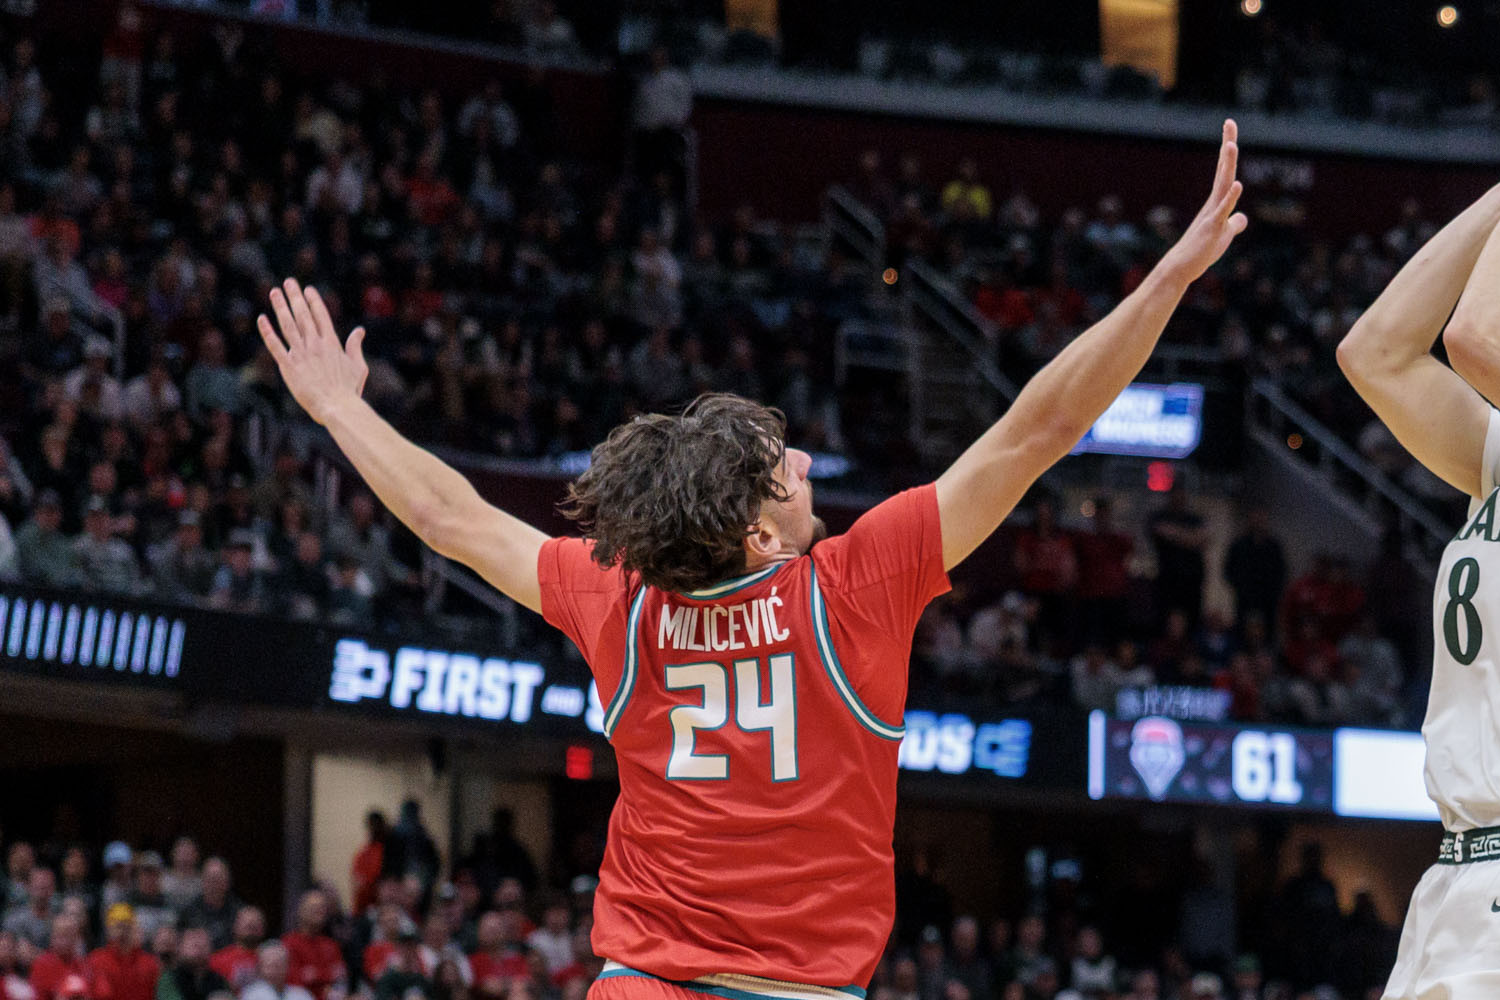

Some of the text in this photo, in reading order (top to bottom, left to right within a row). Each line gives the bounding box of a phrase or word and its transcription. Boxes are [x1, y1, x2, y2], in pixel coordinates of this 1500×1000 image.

[1443, 557, 1483, 666] 8
[389, 648, 545, 723] FIRST
[664, 652, 800, 783] 24
[1233, 730, 1301, 803] 61
